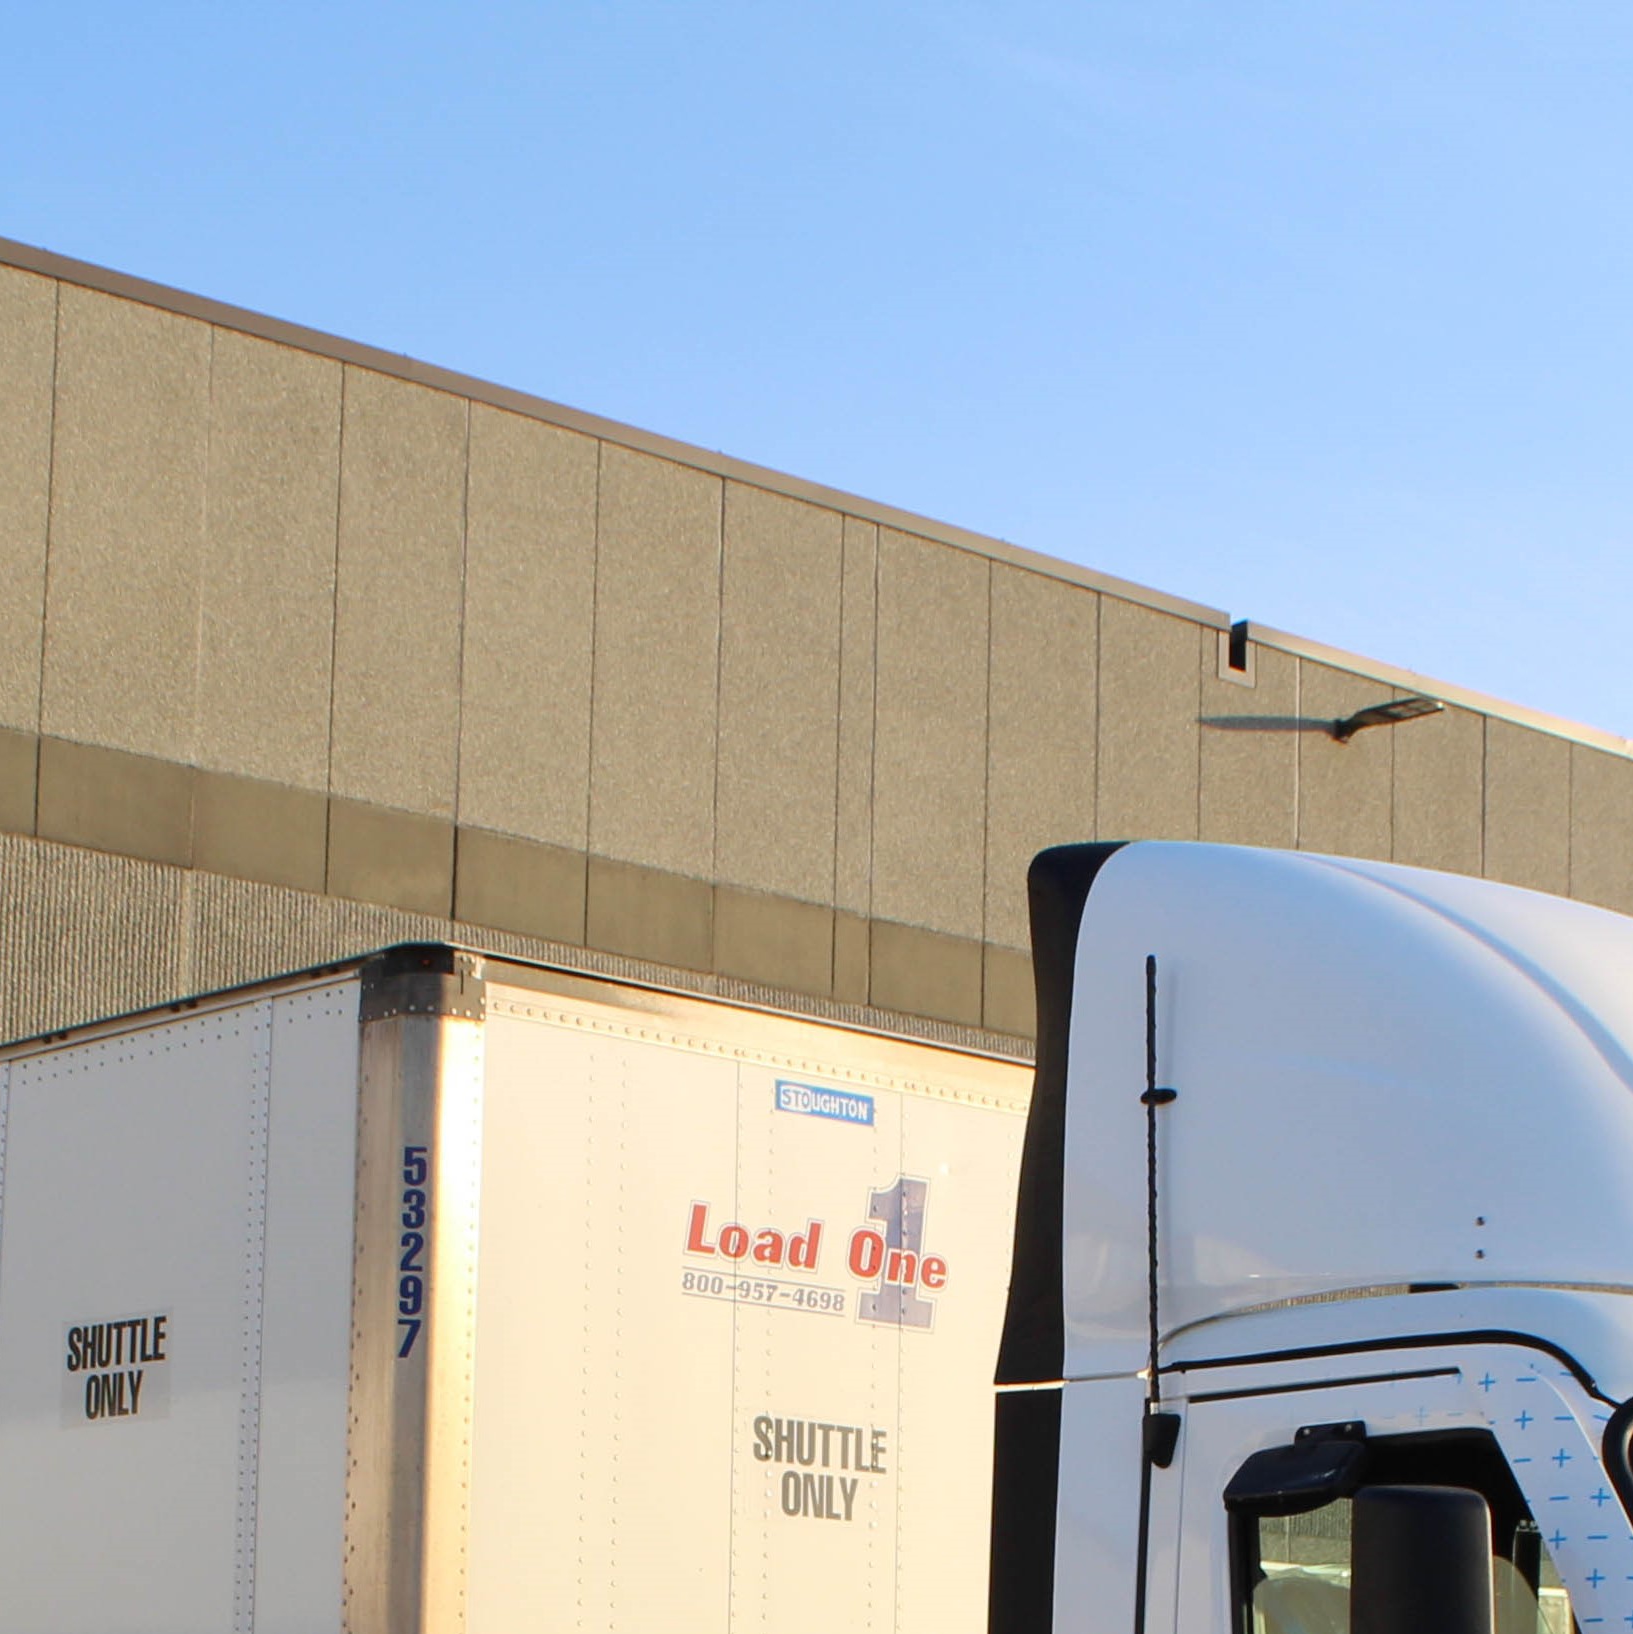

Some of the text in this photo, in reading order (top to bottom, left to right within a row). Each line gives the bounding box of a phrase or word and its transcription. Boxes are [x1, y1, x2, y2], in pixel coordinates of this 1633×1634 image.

[782, 1088, 868, 1120] STOUGHTON
[398, 1147, 427, 1357] 53297
[684, 1201, 948, 1290] Load One
[682, 1272, 845, 1312] 800-957-4698
[67, 1315, 167, 1372] SHUTTLE
[85, 1370, 143, 1420] ONLY
[753, 1415, 887, 1474] SHUTTLE
[781, 1471, 858, 1521] ONLY
